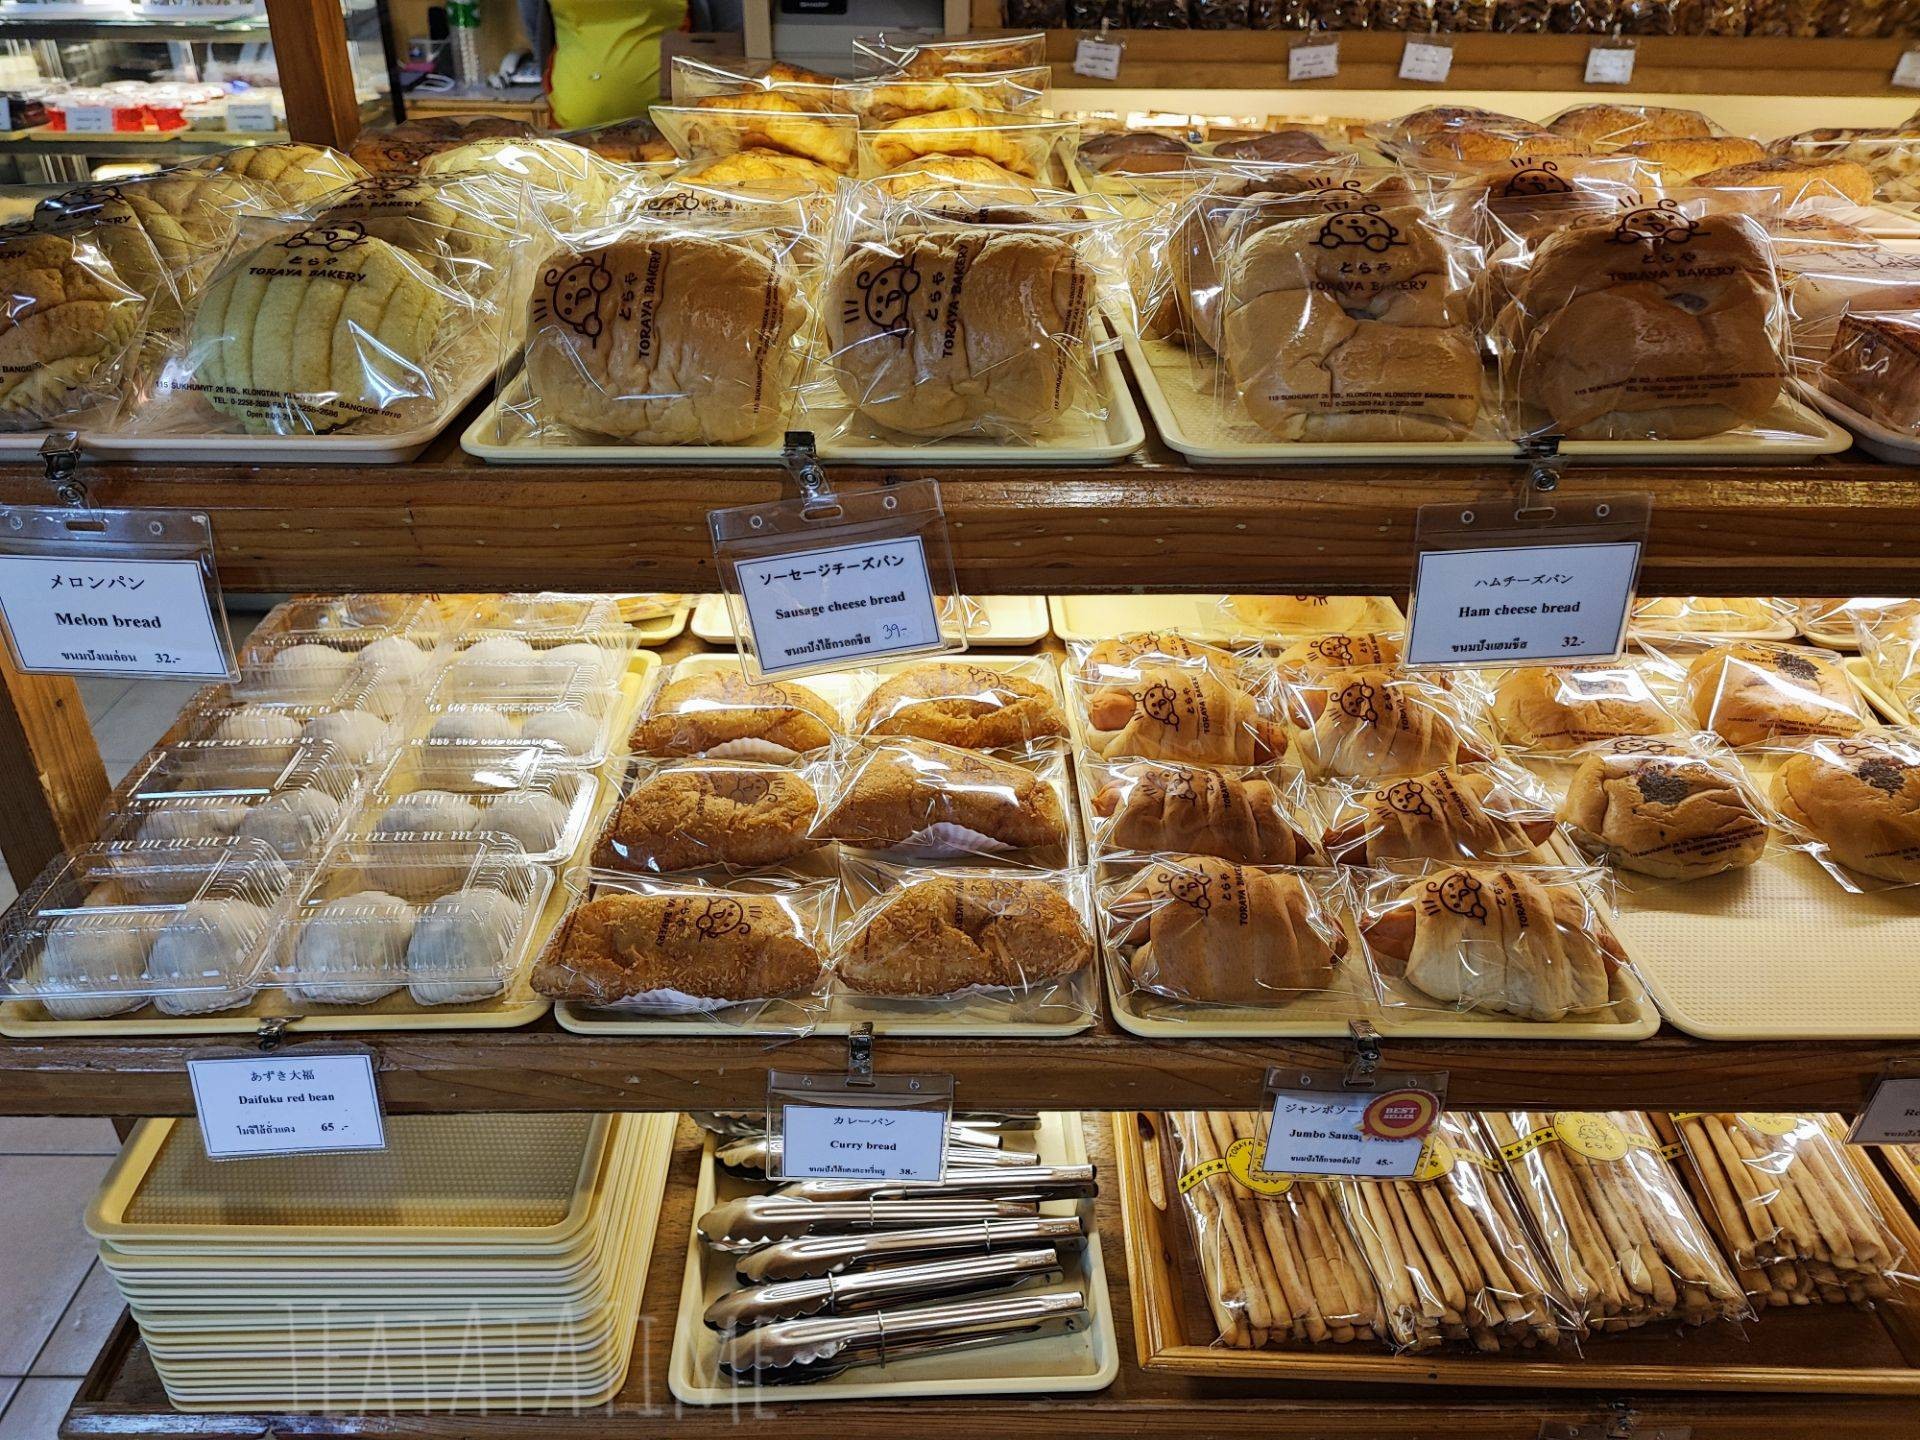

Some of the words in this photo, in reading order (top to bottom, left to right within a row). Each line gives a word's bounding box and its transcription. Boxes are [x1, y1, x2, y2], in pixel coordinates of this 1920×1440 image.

[289, 256, 338, 266] とらや
[1340, 261, 1393, 275] とらや
[249, 267, 303, 277] TORAYA
[308, 269, 367, 282] BAKERY
[643, 249, 663, 298] BAKERY
[951, 244, 970, 296] BAKERY
[1607, 270, 1670, 282] TORAYA
[1675, 265, 1736, 278] BAKERY
[639, 299, 654, 360] TORAYA
[942, 300, 961, 359] TORAYA
[215, 385, 225, 394] 26
[338, 401, 380, 416] BANGKOK
[760, 555, 904, 586] ソーセージチーズパン
[51, 574, 145, 591] メロンパン
[1475, 574, 1574, 588] ハムチーズパン
[775, 604, 825, 620] Sausage
[828, 599, 867, 613] cheese
[870, 591, 906, 606] bread
[1458, 606, 1491, 618] Ham
[1494, 604, 1537, 616] cheese
[1541, 601, 1581, 614] bread
[54, 612, 109, 627] Melon
[112, 614, 162, 629] bread
[1561, 636, 1585, 648] 32.-
[155, 652, 181, 664] 32.-
[250, 1069, 315, 1082] あずき大福
[238, 1095, 283, 1105] Daifuku
[287, 1093, 306, 1103] red
[308, 1092, 335, 1102] bean
[1285, 1103, 1364, 1116] ジャンボソー
[321, 1123, 335, 1132] 65
[833, 1116, 896, 1127] カレーパン
[1289, 1129, 1326, 1139] Jumbo
[830, 1140, 863, 1151] Curry
[866, 1141, 897, 1151] bread
[1376, 1158, 1394, 1166] 45.-
[898, 1168, 917, 1176] 38.-
